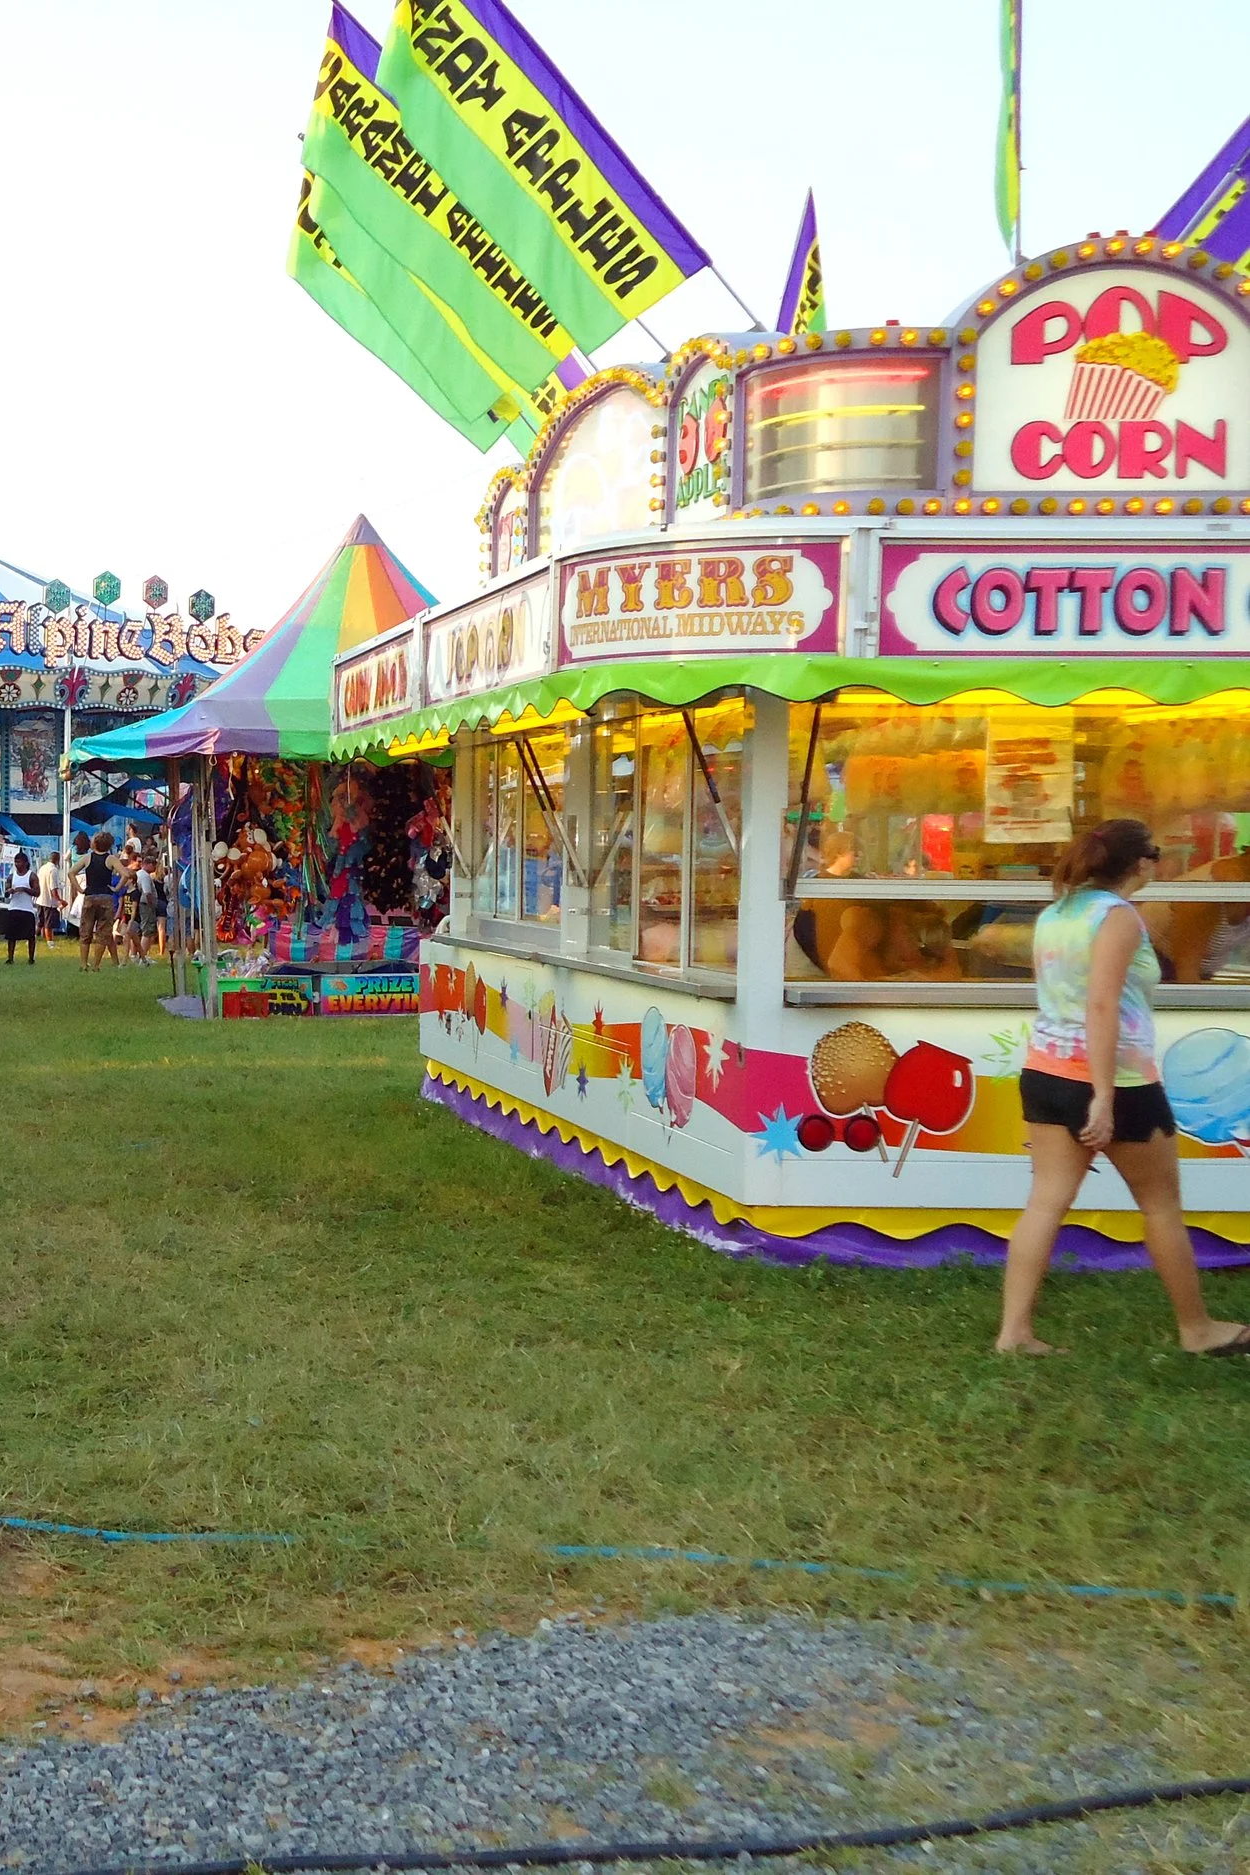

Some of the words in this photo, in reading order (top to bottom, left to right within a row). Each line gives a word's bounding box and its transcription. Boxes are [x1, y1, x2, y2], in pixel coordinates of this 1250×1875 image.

[313, 50, 451, 218] CARAMEL
[502, 108, 659, 300] APPLES
[1011, 285, 1228, 366] POP
[1010, 419, 1227, 480] CORN
[576, 555, 794, 619] MYERS
[933, 565, 1227, 637] COTTON
[569, 616, 674, 647] INTERNATIONAL
[675, 611, 805, 638] MIDWAYS
[355, 976, 416, 994] PRIZE
